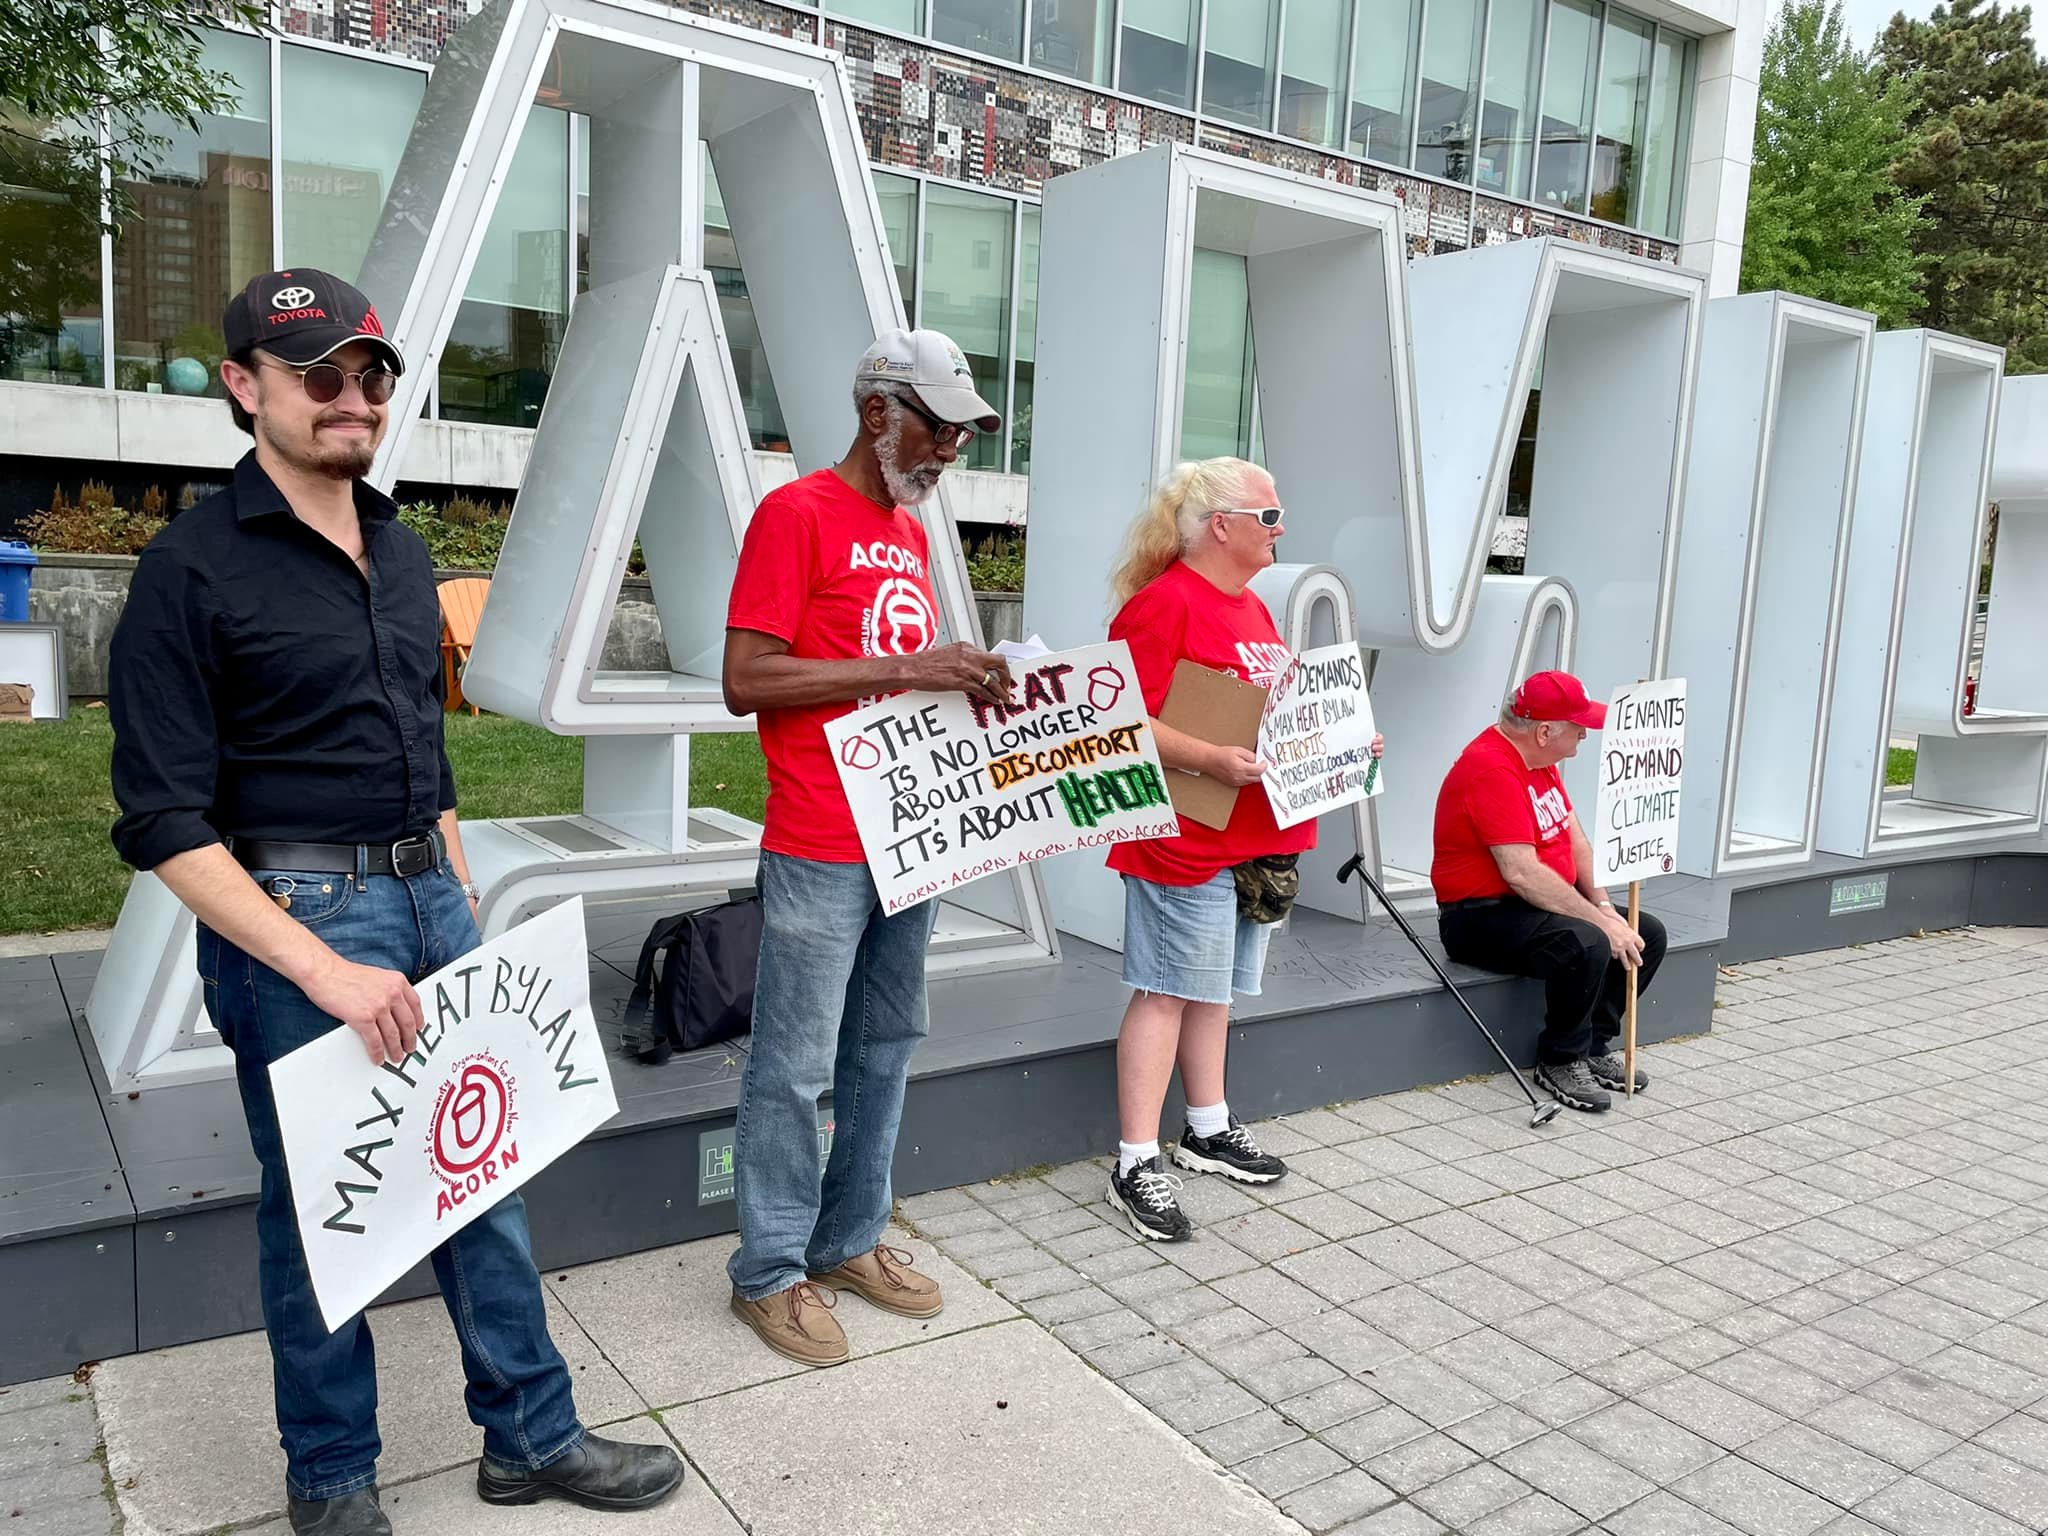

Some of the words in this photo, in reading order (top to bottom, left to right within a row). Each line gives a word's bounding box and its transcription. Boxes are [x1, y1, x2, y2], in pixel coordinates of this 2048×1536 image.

[268, 308, 326, 326] TOYOTA
[1298, 655, 1361, 696] DEMANDS
[1273, 709, 1294, 738] MAX
[1295, 702, 1319, 732] HEAT
[1322, 695, 1355, 727] BYLAW
[1616, 694, 1685, 731] TENANTS
[863, 704, 947, 762] THE
[880, 764, 918, 801] IS
[930, 738, 978, 778] NO
[984, 704, 1098, 758] LONGER
[1275, 731, 1328, 765] RETROFITS
[888, 768, 985, 832] ABOUT
[988, 722, 1145, 790] DISCOMFORT
[1327, 749, 1358, 771] COOLING
[1606, 748, 1682, 786] DEMAND
[959, 785, 1056, 848] ABOUT
[1055, 761, 1169, 828] HEALTH
[1611, 790, 1679, 830] CLIMATE
[1607, 836, 1664, 872] JUSTICE
[322, 1086, 404, 1234] MAX
[379, 965, 482, 1088] HEAT
[489, 956, 598, 1091] BYLAW
[435, 1139, 520, 1221] ACORN
[702, 1188, 729, 1199] PLEASE
